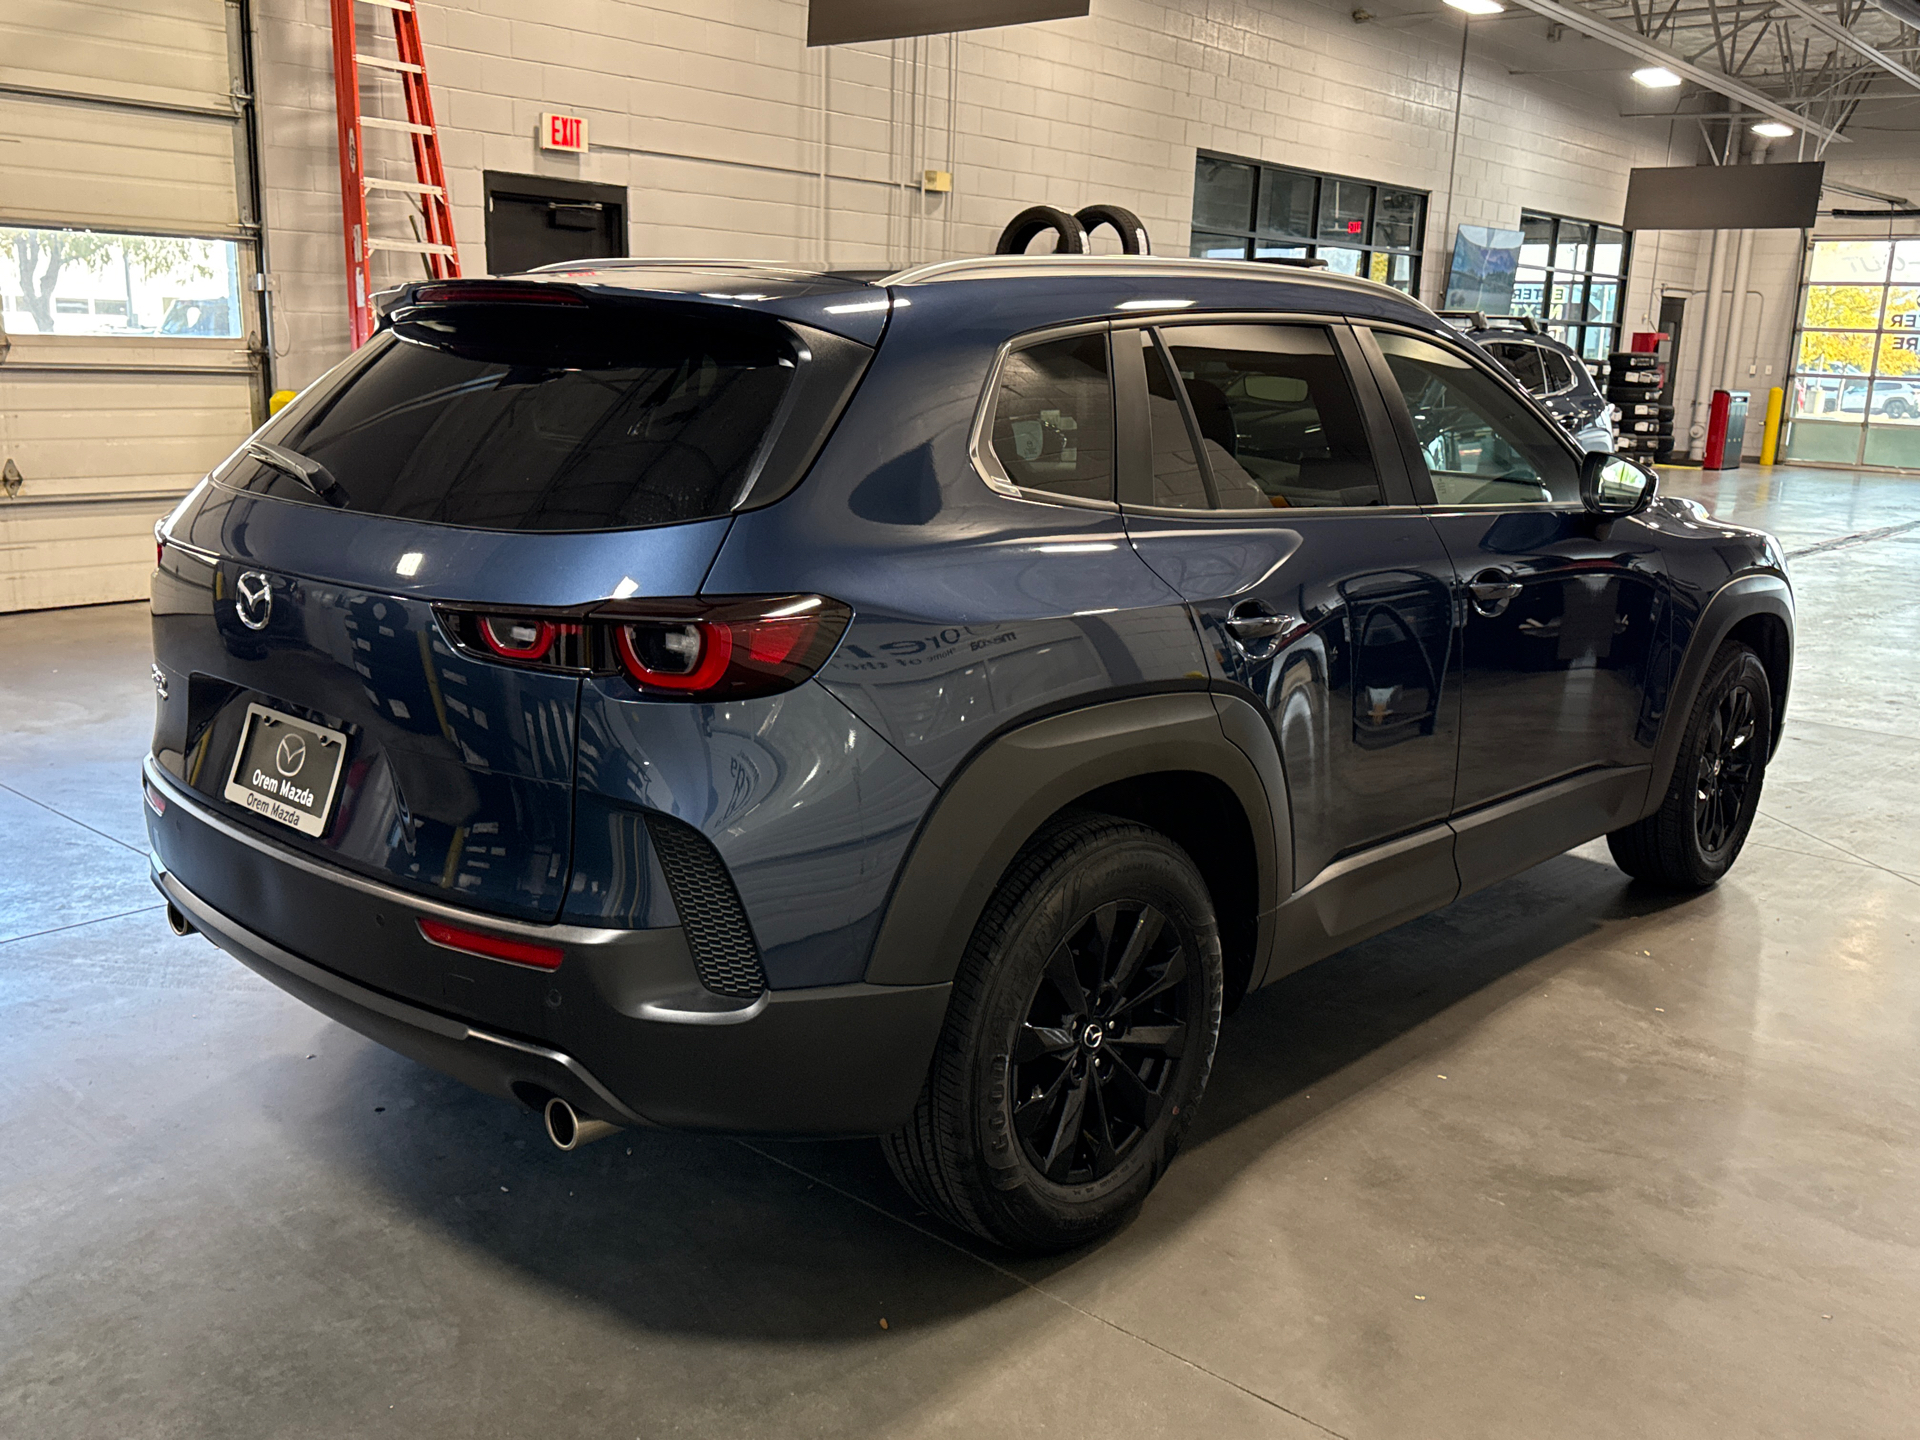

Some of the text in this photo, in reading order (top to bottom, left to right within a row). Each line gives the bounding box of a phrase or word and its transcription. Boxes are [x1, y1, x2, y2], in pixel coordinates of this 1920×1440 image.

[551, 115, 582, 149] EXIT
[252, 769, 314, 808] Orem Mazda
[246, 792, 300, 827] Orem Mazda
